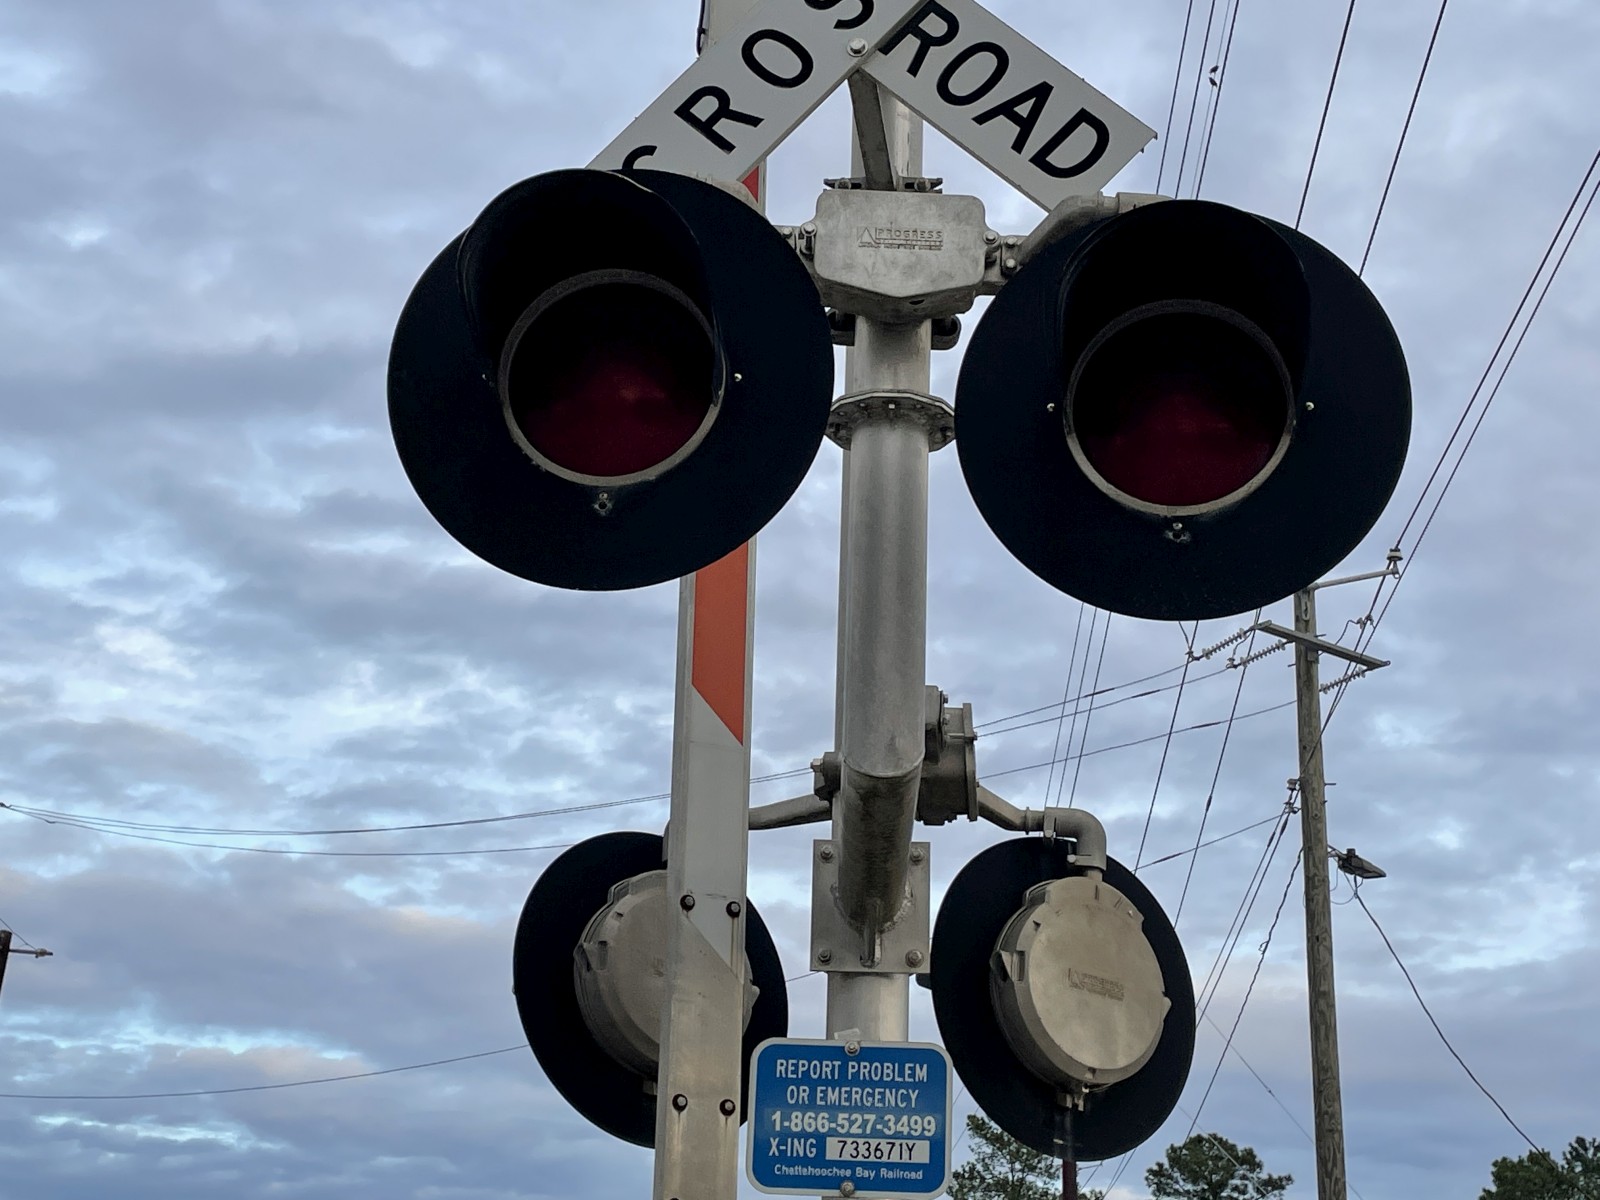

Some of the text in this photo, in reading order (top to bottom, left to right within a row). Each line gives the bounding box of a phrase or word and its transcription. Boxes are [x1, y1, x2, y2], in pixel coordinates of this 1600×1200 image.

[877, 0, 1110, 178] ROAD
[877, 228, 943, 239] PROGRESS
[776, 1059, 928, 1082] REPORT PROBLEM
[787, 1085, 919, 1108] OR EMERGENCY
[771, 1110, 936, 1136] 1-866-527-3499
[768, 1137, 916, 1161] X-ING 733671Y
[855, 1168, 875, 1179] Bay
[880, 1168, 923, 1179] Railroad
